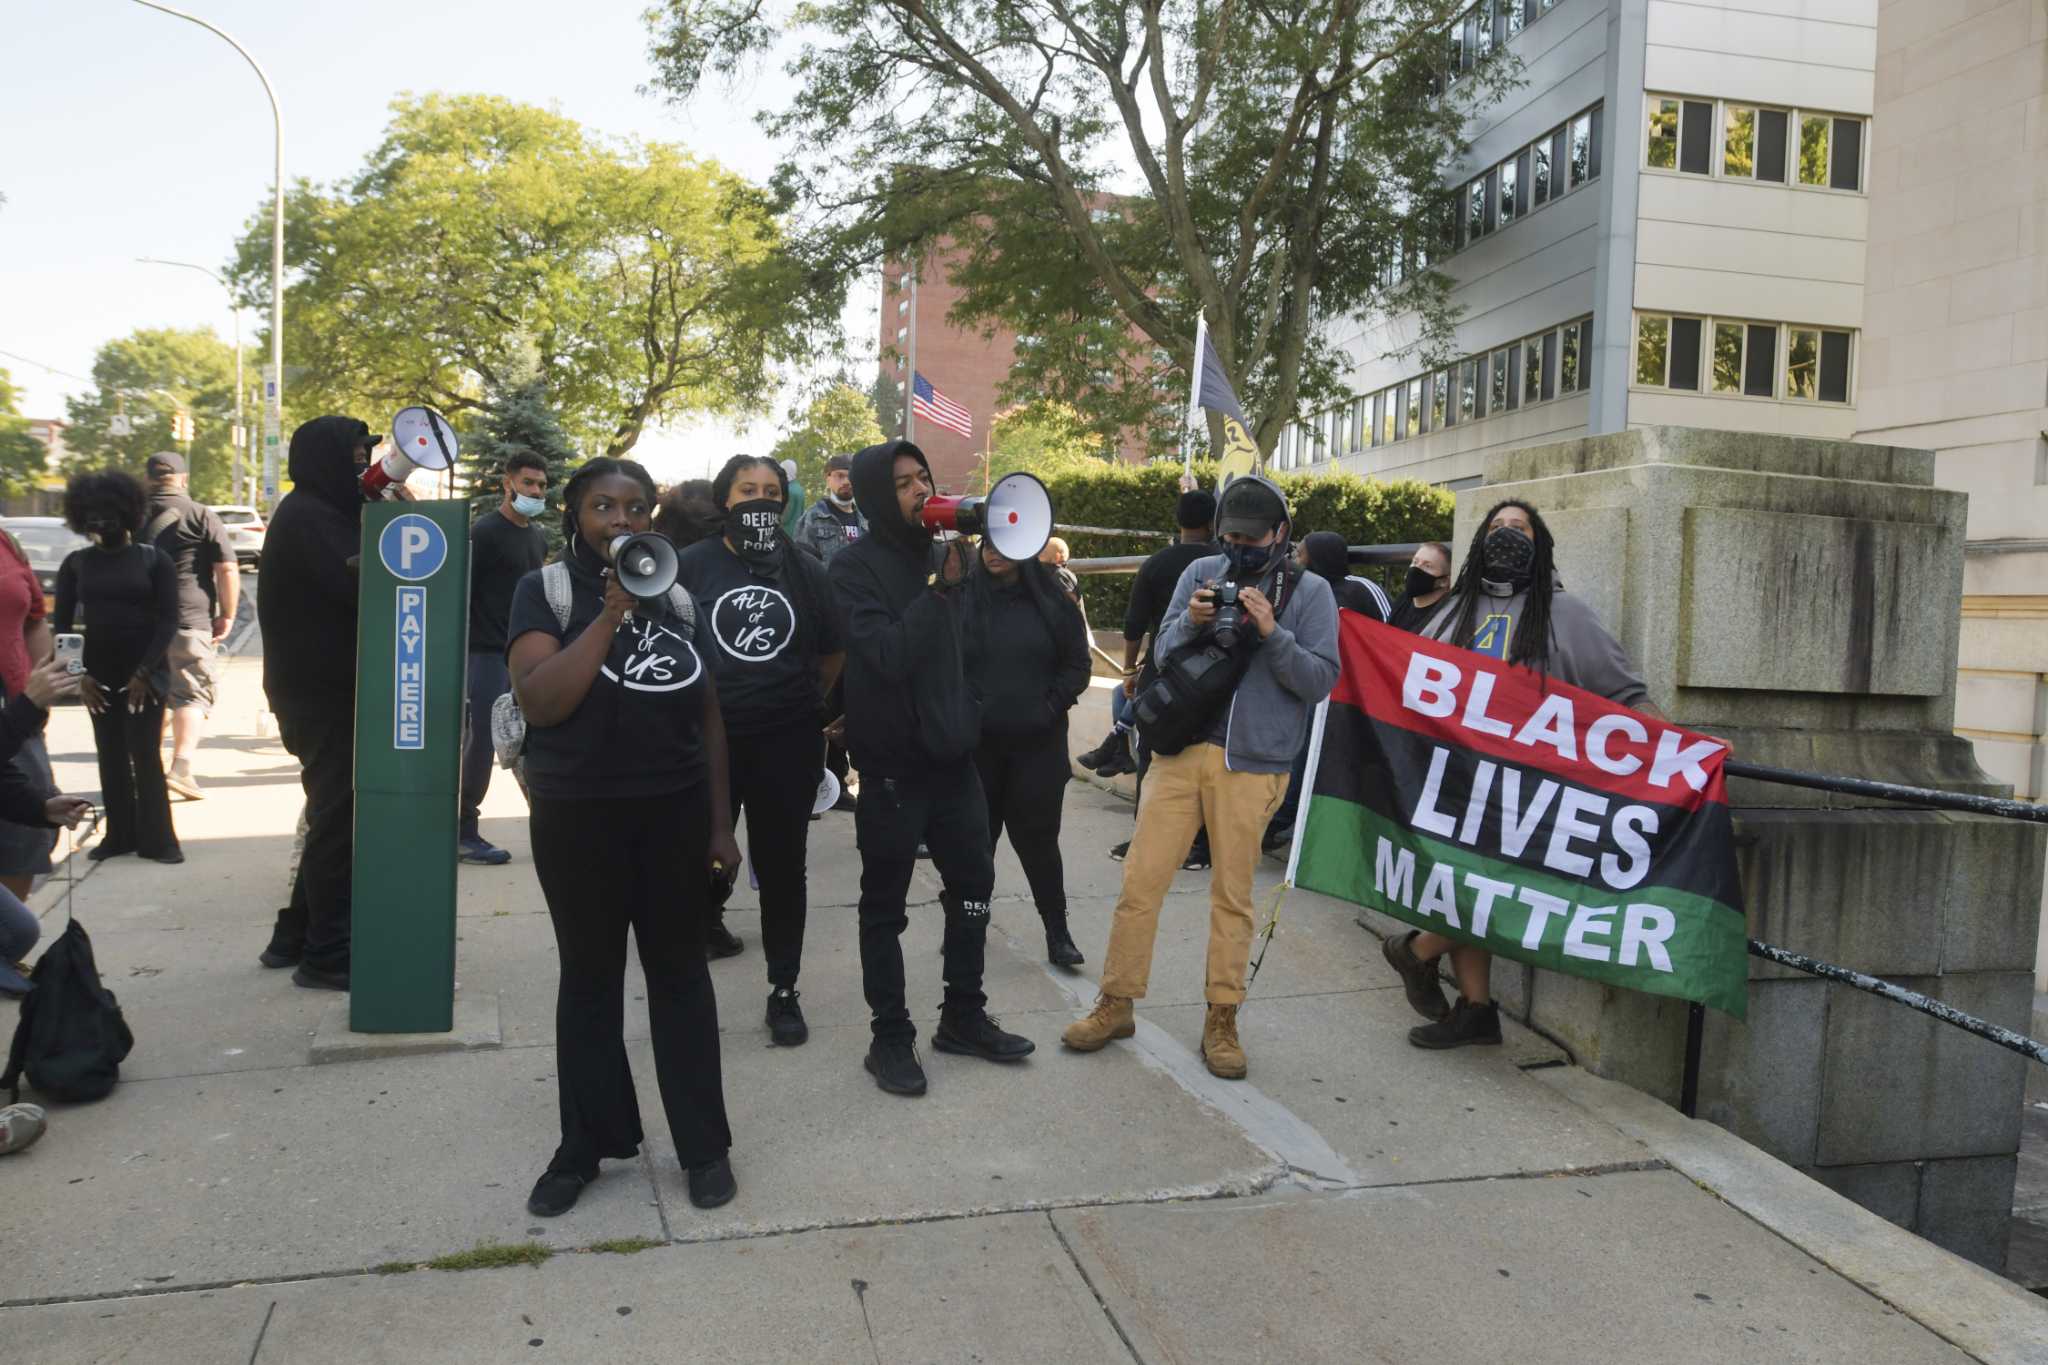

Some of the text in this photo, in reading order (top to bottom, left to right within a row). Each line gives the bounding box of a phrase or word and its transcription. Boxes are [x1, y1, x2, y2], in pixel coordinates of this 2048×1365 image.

[401, 526, 429, 570] P
[731, 592, 775, 610] ALL
[734, 626, 775, 652] US
[400, 593, 421, 742] PAY HERE
[624, 653, 677, 680] US
[1402, 651, 1726, 793] BLACK
[1411, 746, 1659, 890] LIVES
[1374, 835, 1676, 973] MATTER
